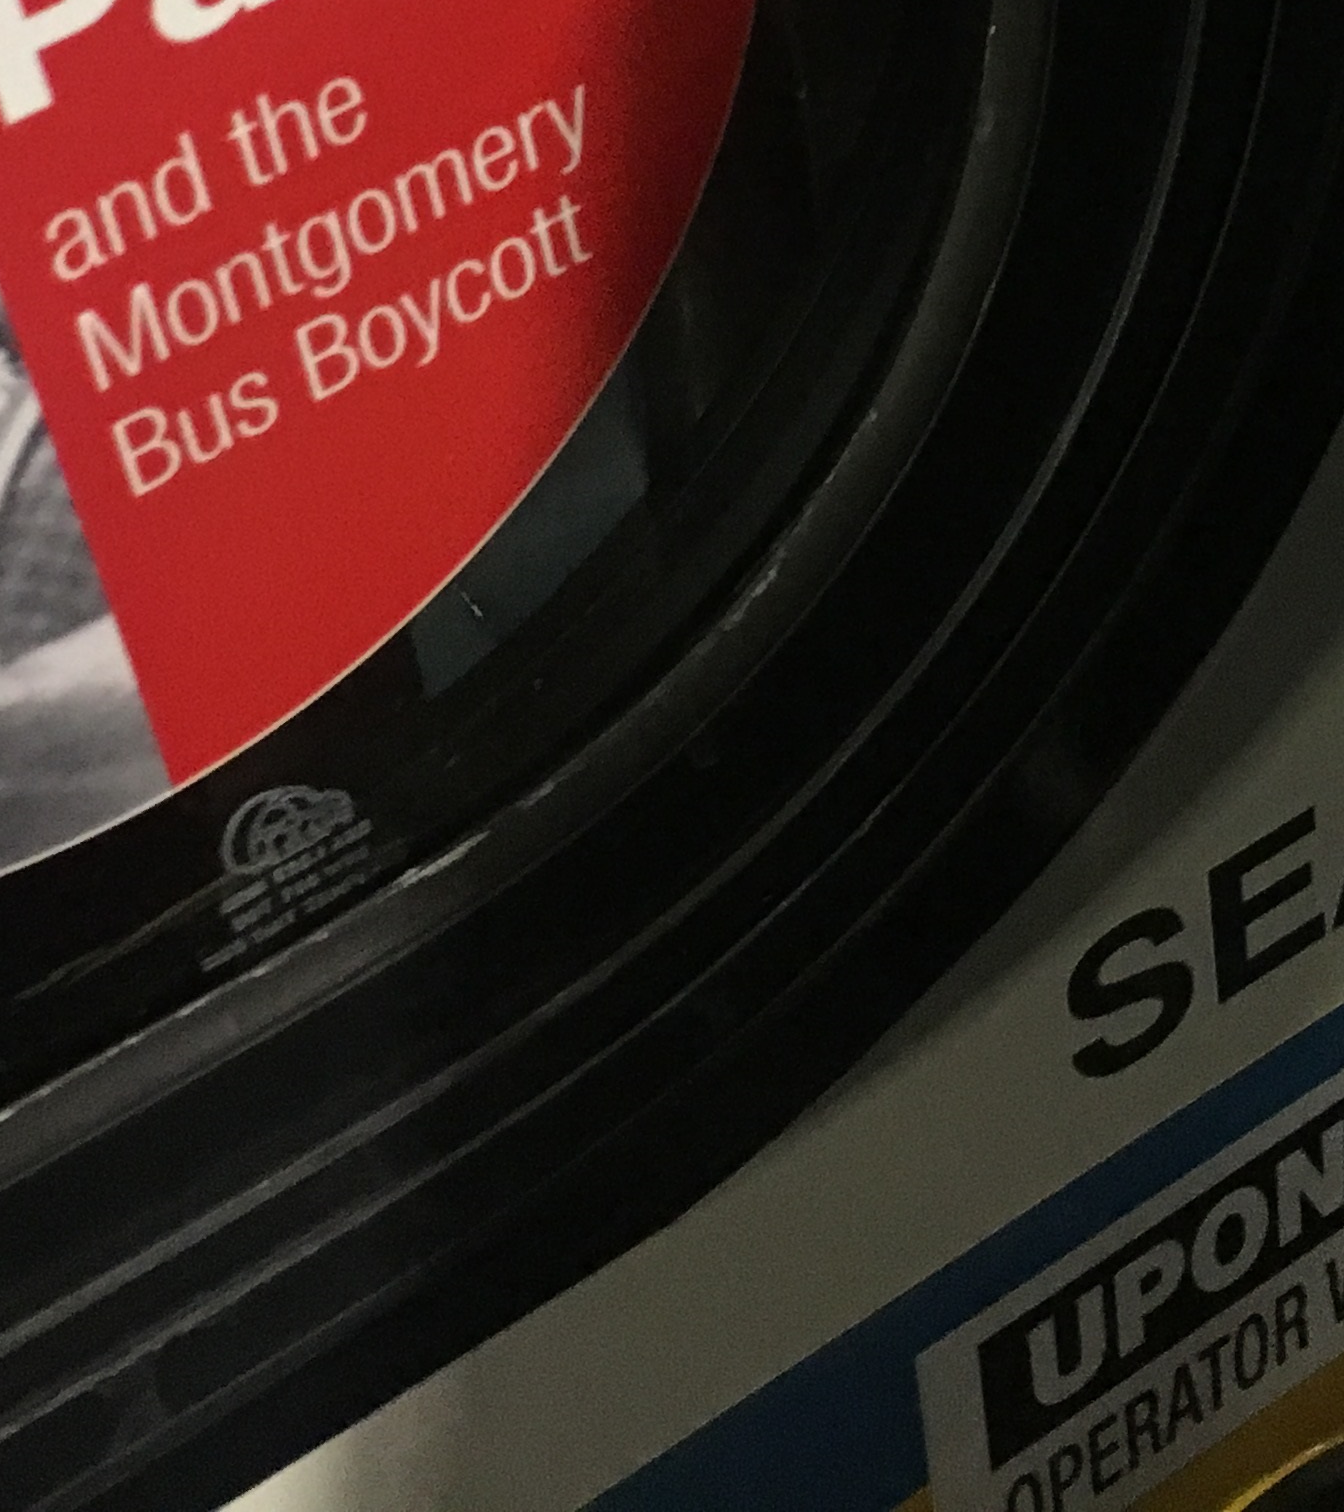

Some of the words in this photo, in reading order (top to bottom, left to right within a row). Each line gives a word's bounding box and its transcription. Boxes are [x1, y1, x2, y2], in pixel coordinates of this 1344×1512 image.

[45, 134, 211, 283] and
[229, 75, 369, 189] the
[76, 85, 587, 392] Montgomery
[112, 368, 279, 497] Bus
[294, 196, 594, 402] Boycott
[1007, 1285, 1309, 1512] OPERATOR
